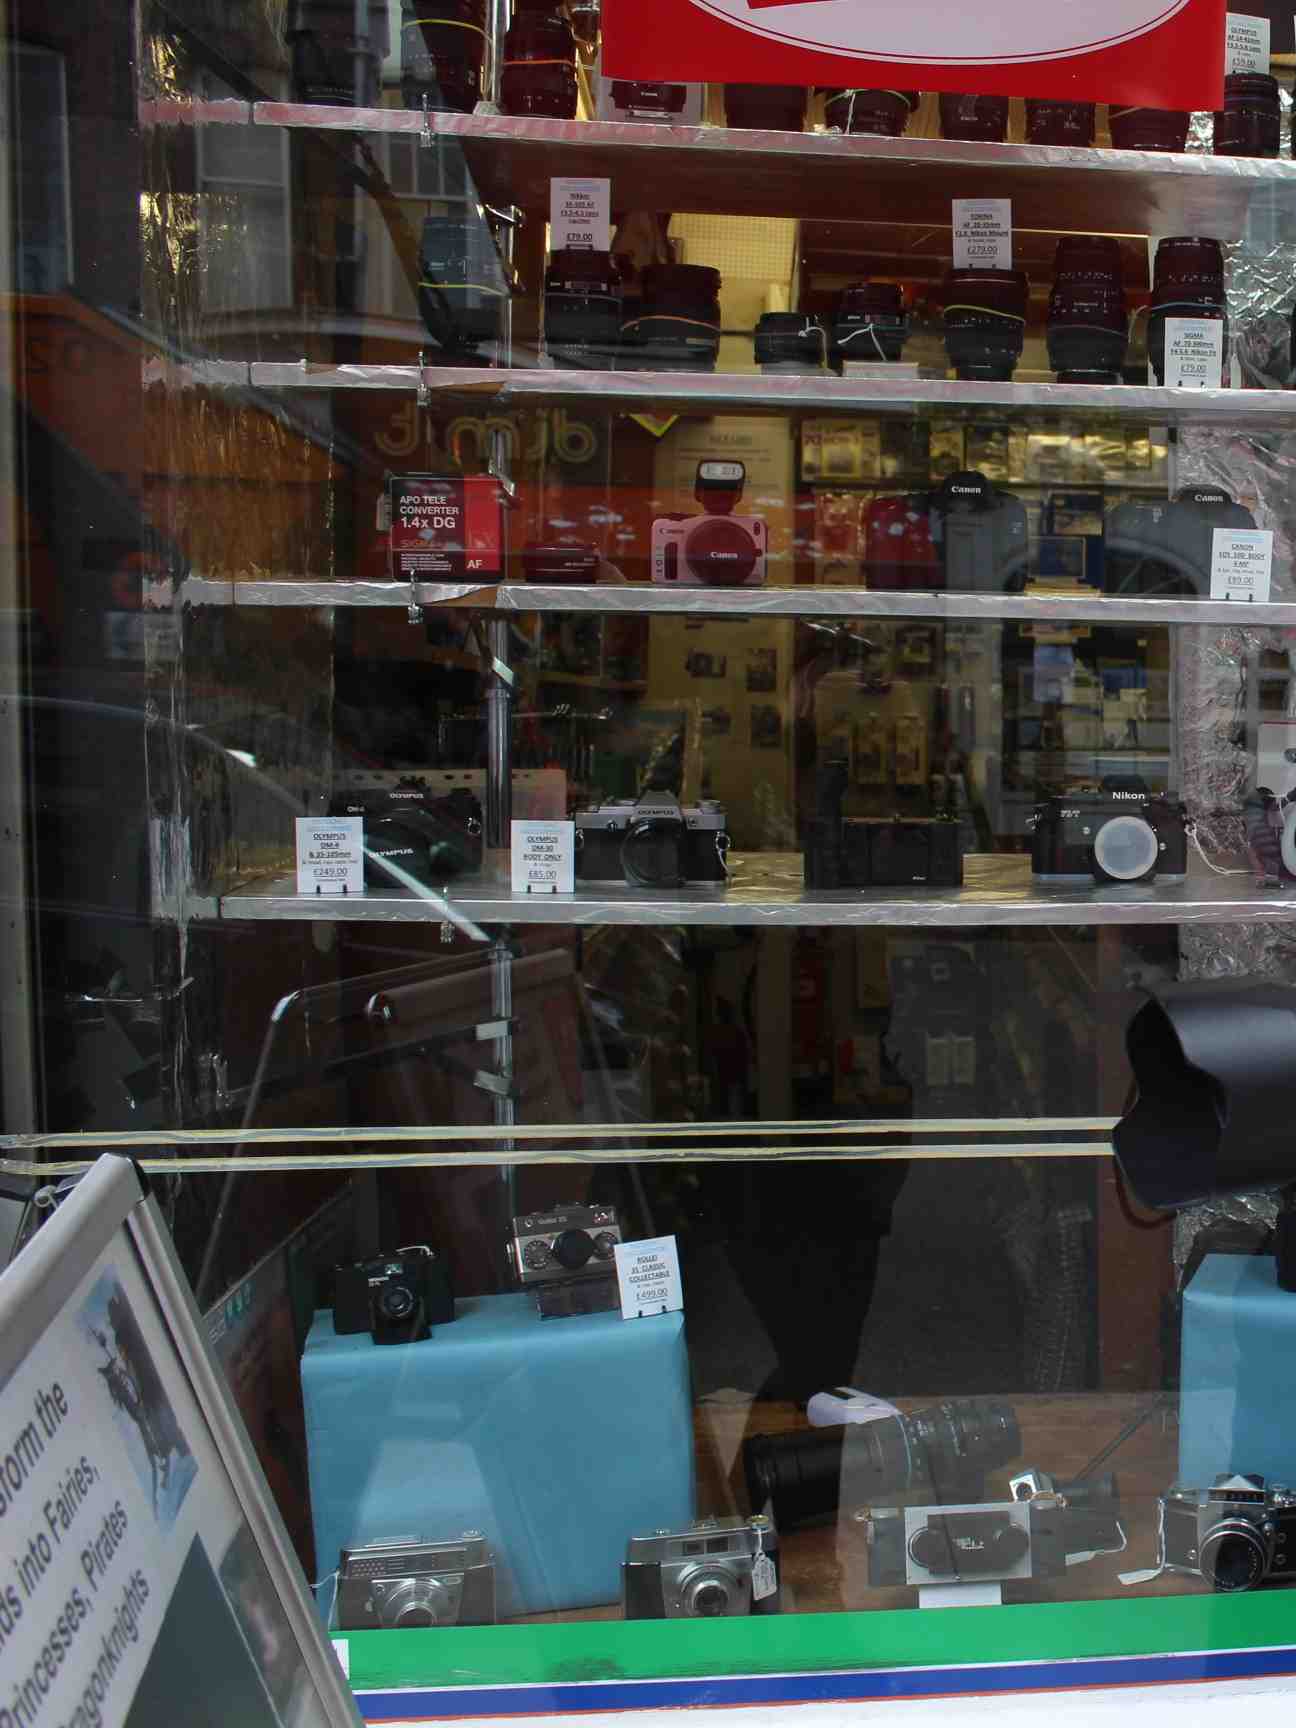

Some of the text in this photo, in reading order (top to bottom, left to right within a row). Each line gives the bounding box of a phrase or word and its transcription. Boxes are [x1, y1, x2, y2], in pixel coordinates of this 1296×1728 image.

[951, 486, 982, 494] Canon
[400, 496, 447, 505] APO TELE
[1194, 494, 1224, 502] Canon
[400, 506, 460, 515] CONVERTER
[400, 516, 457, 529] 1.4x DG
[710, 551, 738, 559] Canon
[466, 559, 484, 569] AF
[1112, 791, 1145, 800] Nikon
[36, 1380, 69, 1439] the
[14, 1530, 52, 1598] into
[43, 1454, 100, 1545] Fairies,
[80, 1499, 129, 1593] Pirates
